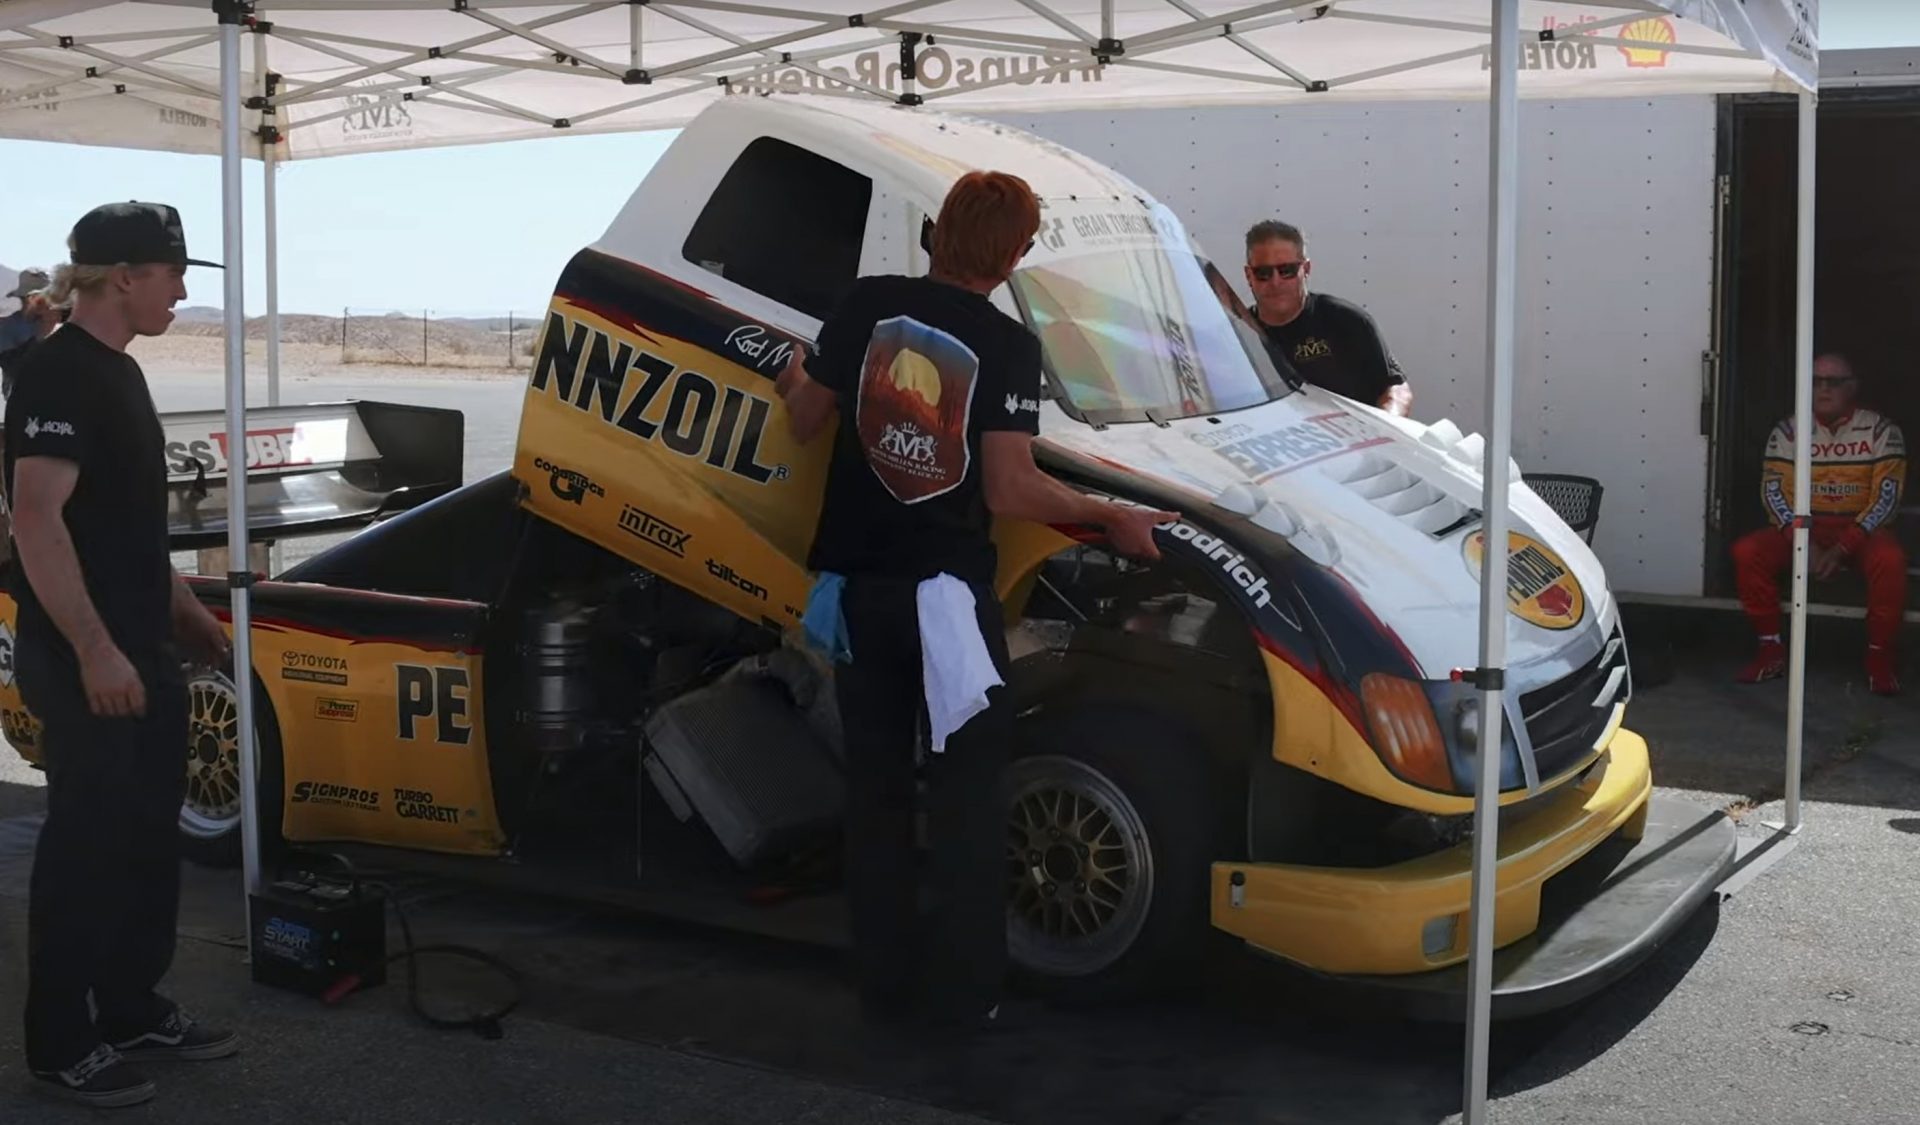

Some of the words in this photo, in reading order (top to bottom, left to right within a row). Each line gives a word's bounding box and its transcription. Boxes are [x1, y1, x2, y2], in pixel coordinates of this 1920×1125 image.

[1072, 215, 1112, 238] GRAN
[724, 324, 769, 358] Rod
[531, 311, 775, 486] NNZOIL
[1810, 441, 1872, 458] OYOTA
[1810, 484, 1859, 495] ENNZOIL
[618, 504, 692, 557] intrax
[705, 557, 768, 601] tilton
[300, 653, 348, 671] TOYOTA
[397, 663, 472, 745] PE
[291, 781, 379, 804] SIGNPROS
[394, 788, 433, 804] TURBO
[395, 801, 460, 824] GARRETT
